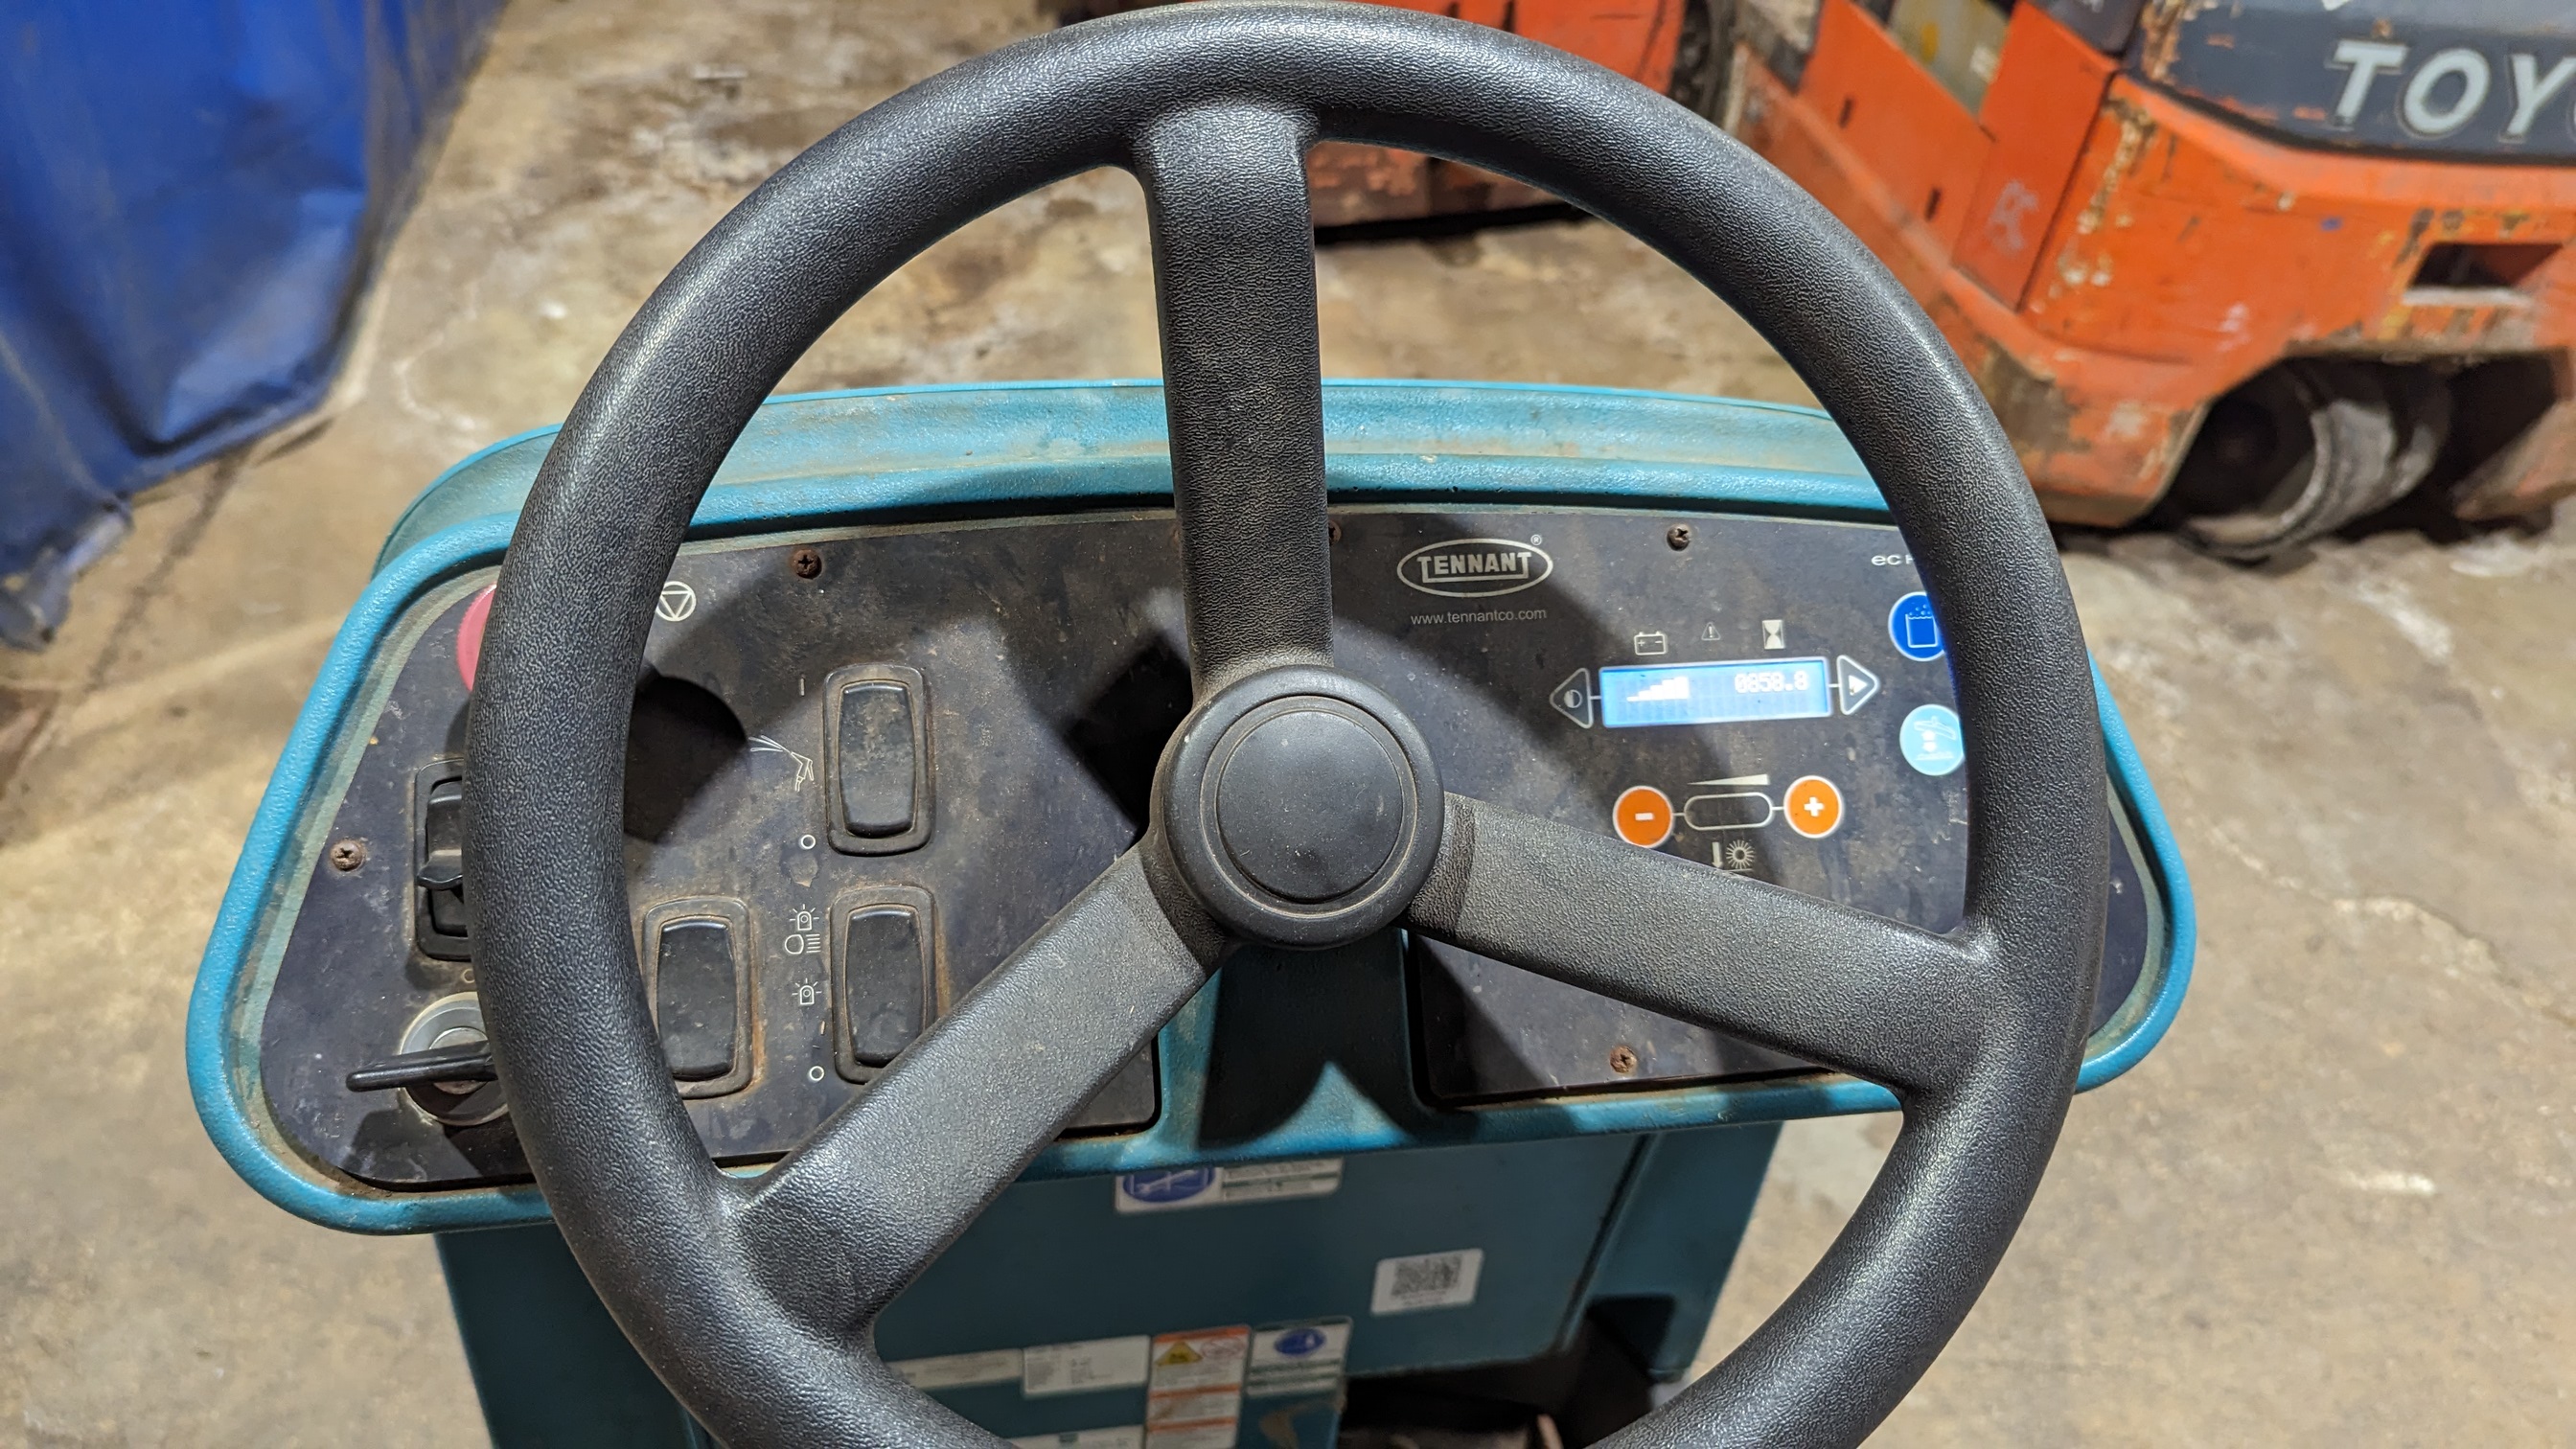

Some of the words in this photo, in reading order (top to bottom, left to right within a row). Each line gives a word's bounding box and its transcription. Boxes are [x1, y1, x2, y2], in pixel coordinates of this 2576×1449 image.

[2328, 38, 2576, 138] TOY
[1416, 551, 1532, 584] TENNANT
[1410, 608, 1549, 626] www.tennantco.com
